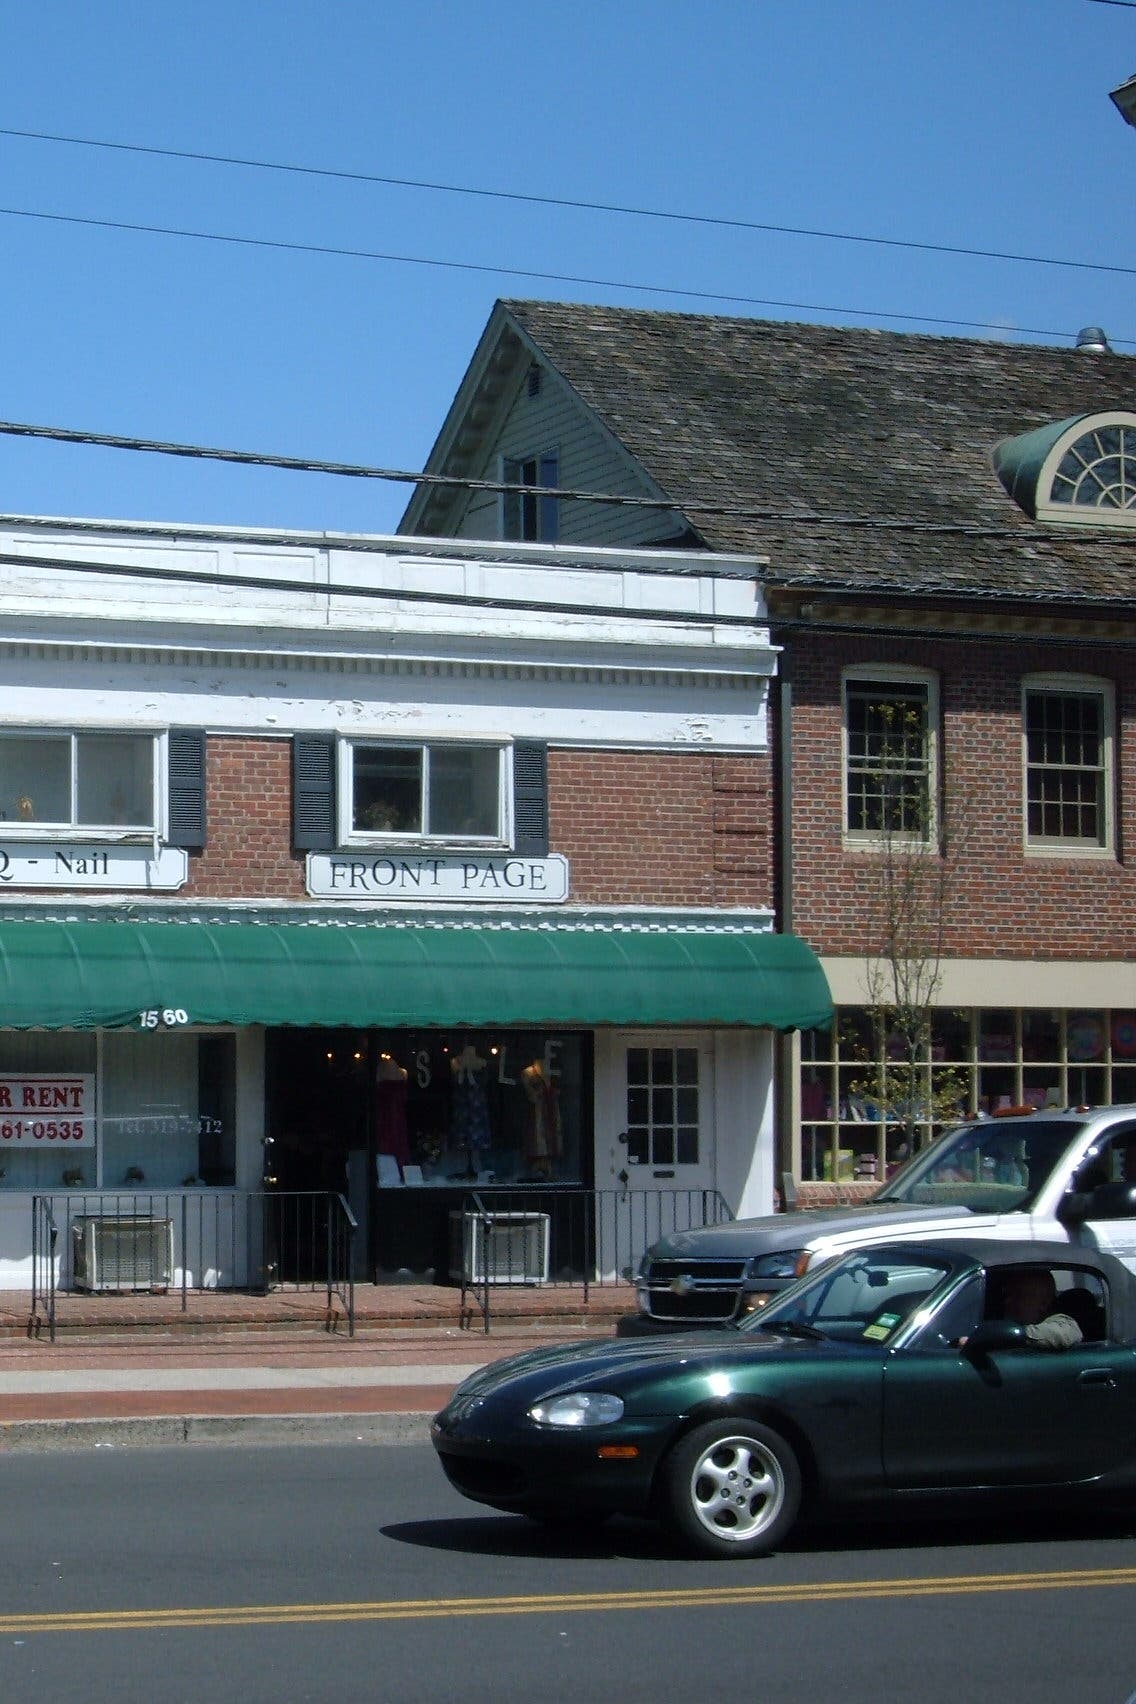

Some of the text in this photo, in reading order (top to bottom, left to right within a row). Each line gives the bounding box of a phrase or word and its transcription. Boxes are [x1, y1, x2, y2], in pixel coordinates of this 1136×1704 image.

[54, 851, 109, 875] Nail
[330, 859, 548, 891] FRONT PAGE
[22, 1086, 84, 1108] RENT
